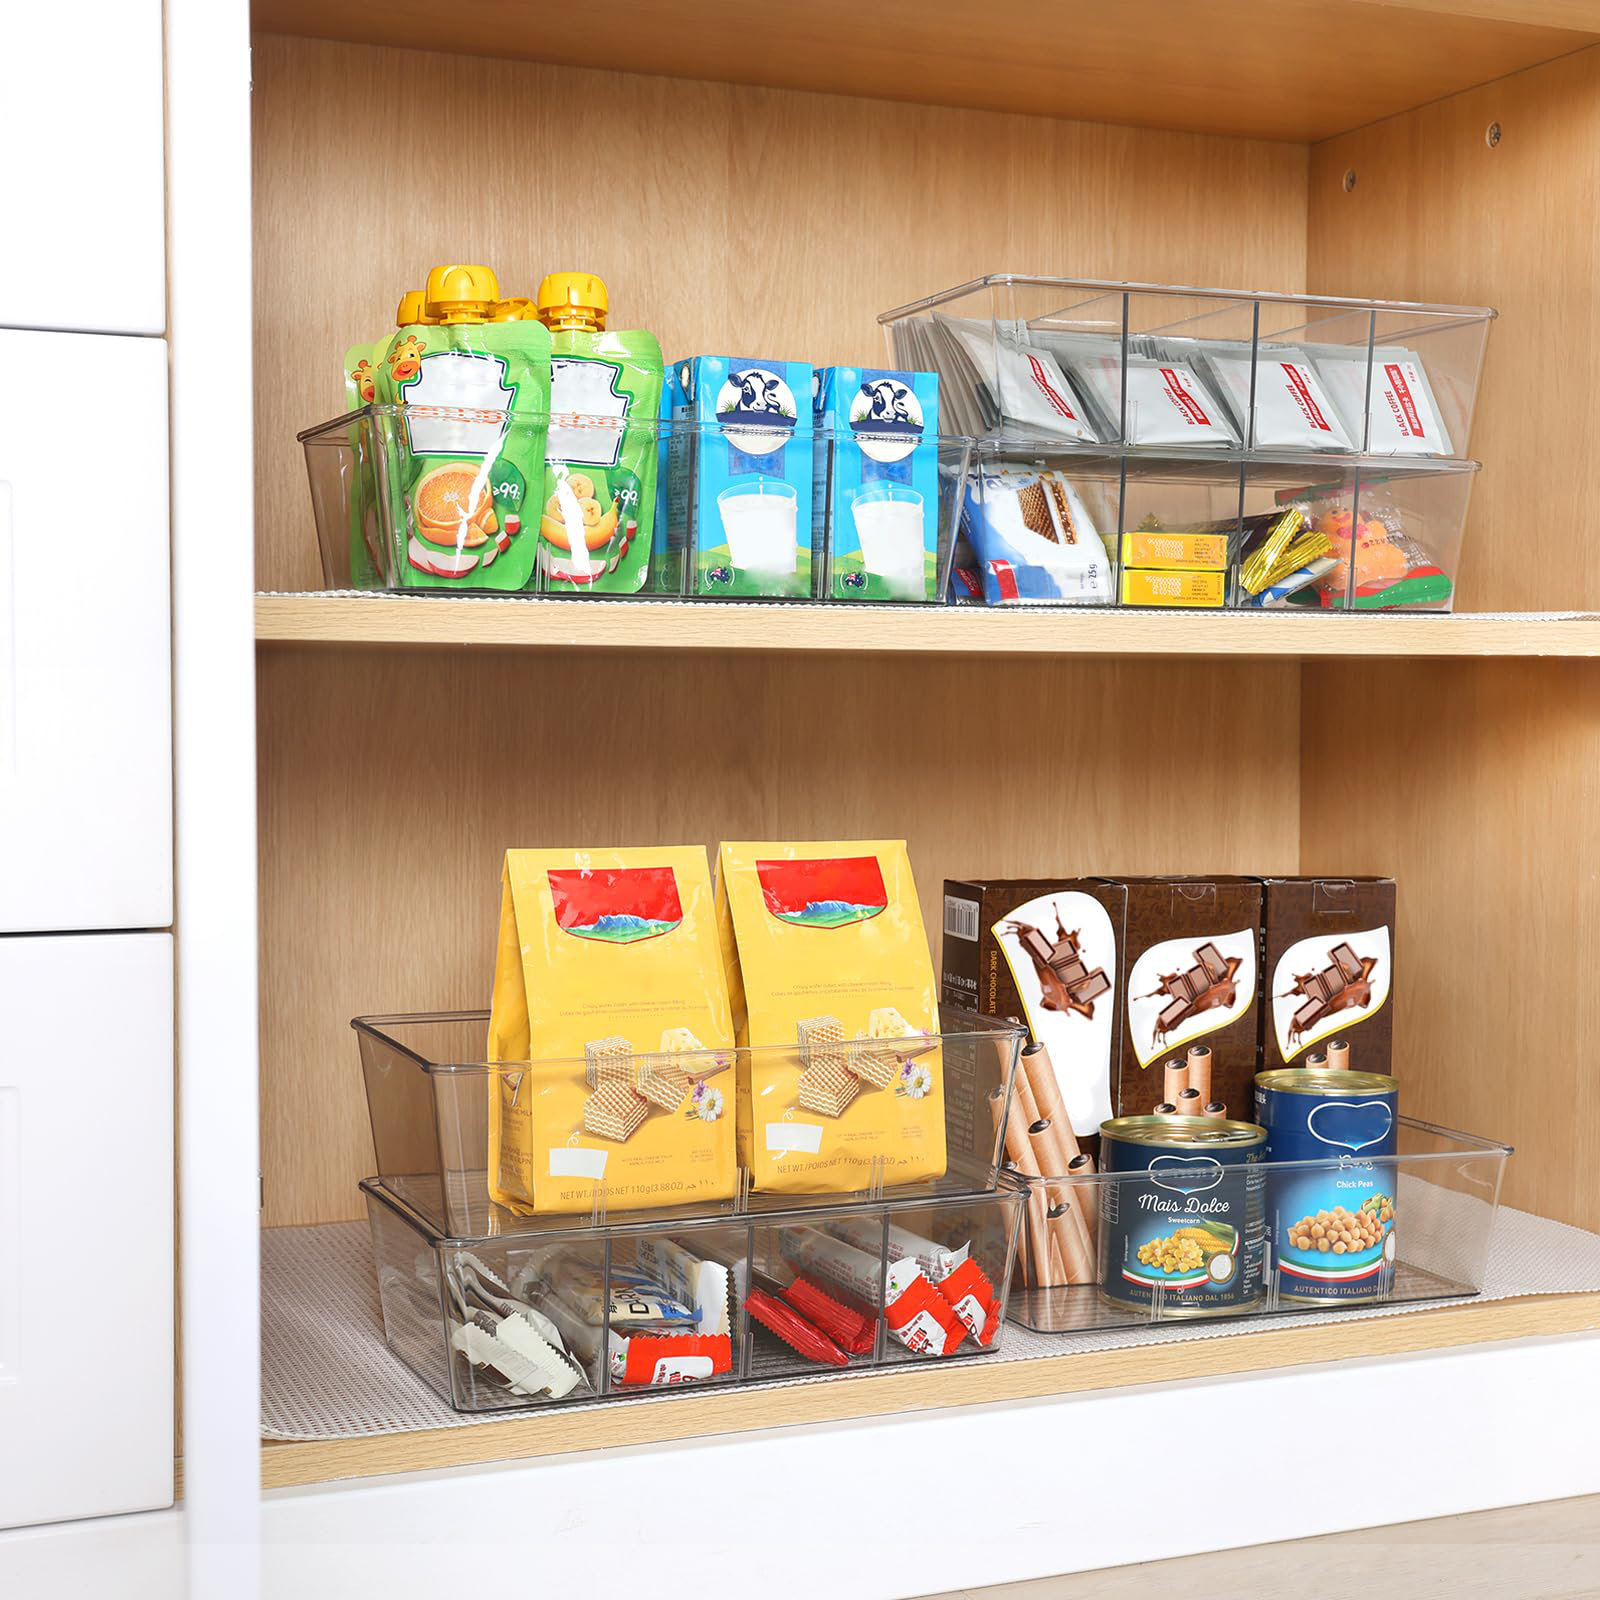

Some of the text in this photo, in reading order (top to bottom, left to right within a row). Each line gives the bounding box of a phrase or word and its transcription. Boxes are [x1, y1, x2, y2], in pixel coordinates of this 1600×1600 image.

[1285, 384, 1304, 406] COFFEE
[1384, 390, 1400, 413] COFFEE
[1299, 406, 1317, 428] BLACK
[1395, 413, 1410, 436] BLACK
[989, 950, 998, 1014] DARK CHOCOLATE
[777, 1164, 791, 1174] NET
[560, 1190, 575, 1200] NET
[615, 1185, 629, 1195] NET
[1336, 1179, 1373, 1189] Chick Peas
[1138, 1193, 1182, 1212] Mais
[1184, 1197, 1230, 1214] Dolce
[1167, 1216, 1201, 1224] Sweetcorn
[1129, 1288, 1168, 1301] AUTENO
[1169, 1294, 1203, 1302] ITALIANO
[1295, 1284, 1338, 1296] AUTENTICO
[1339, 1285, 1372, 1296] ITALIANO
